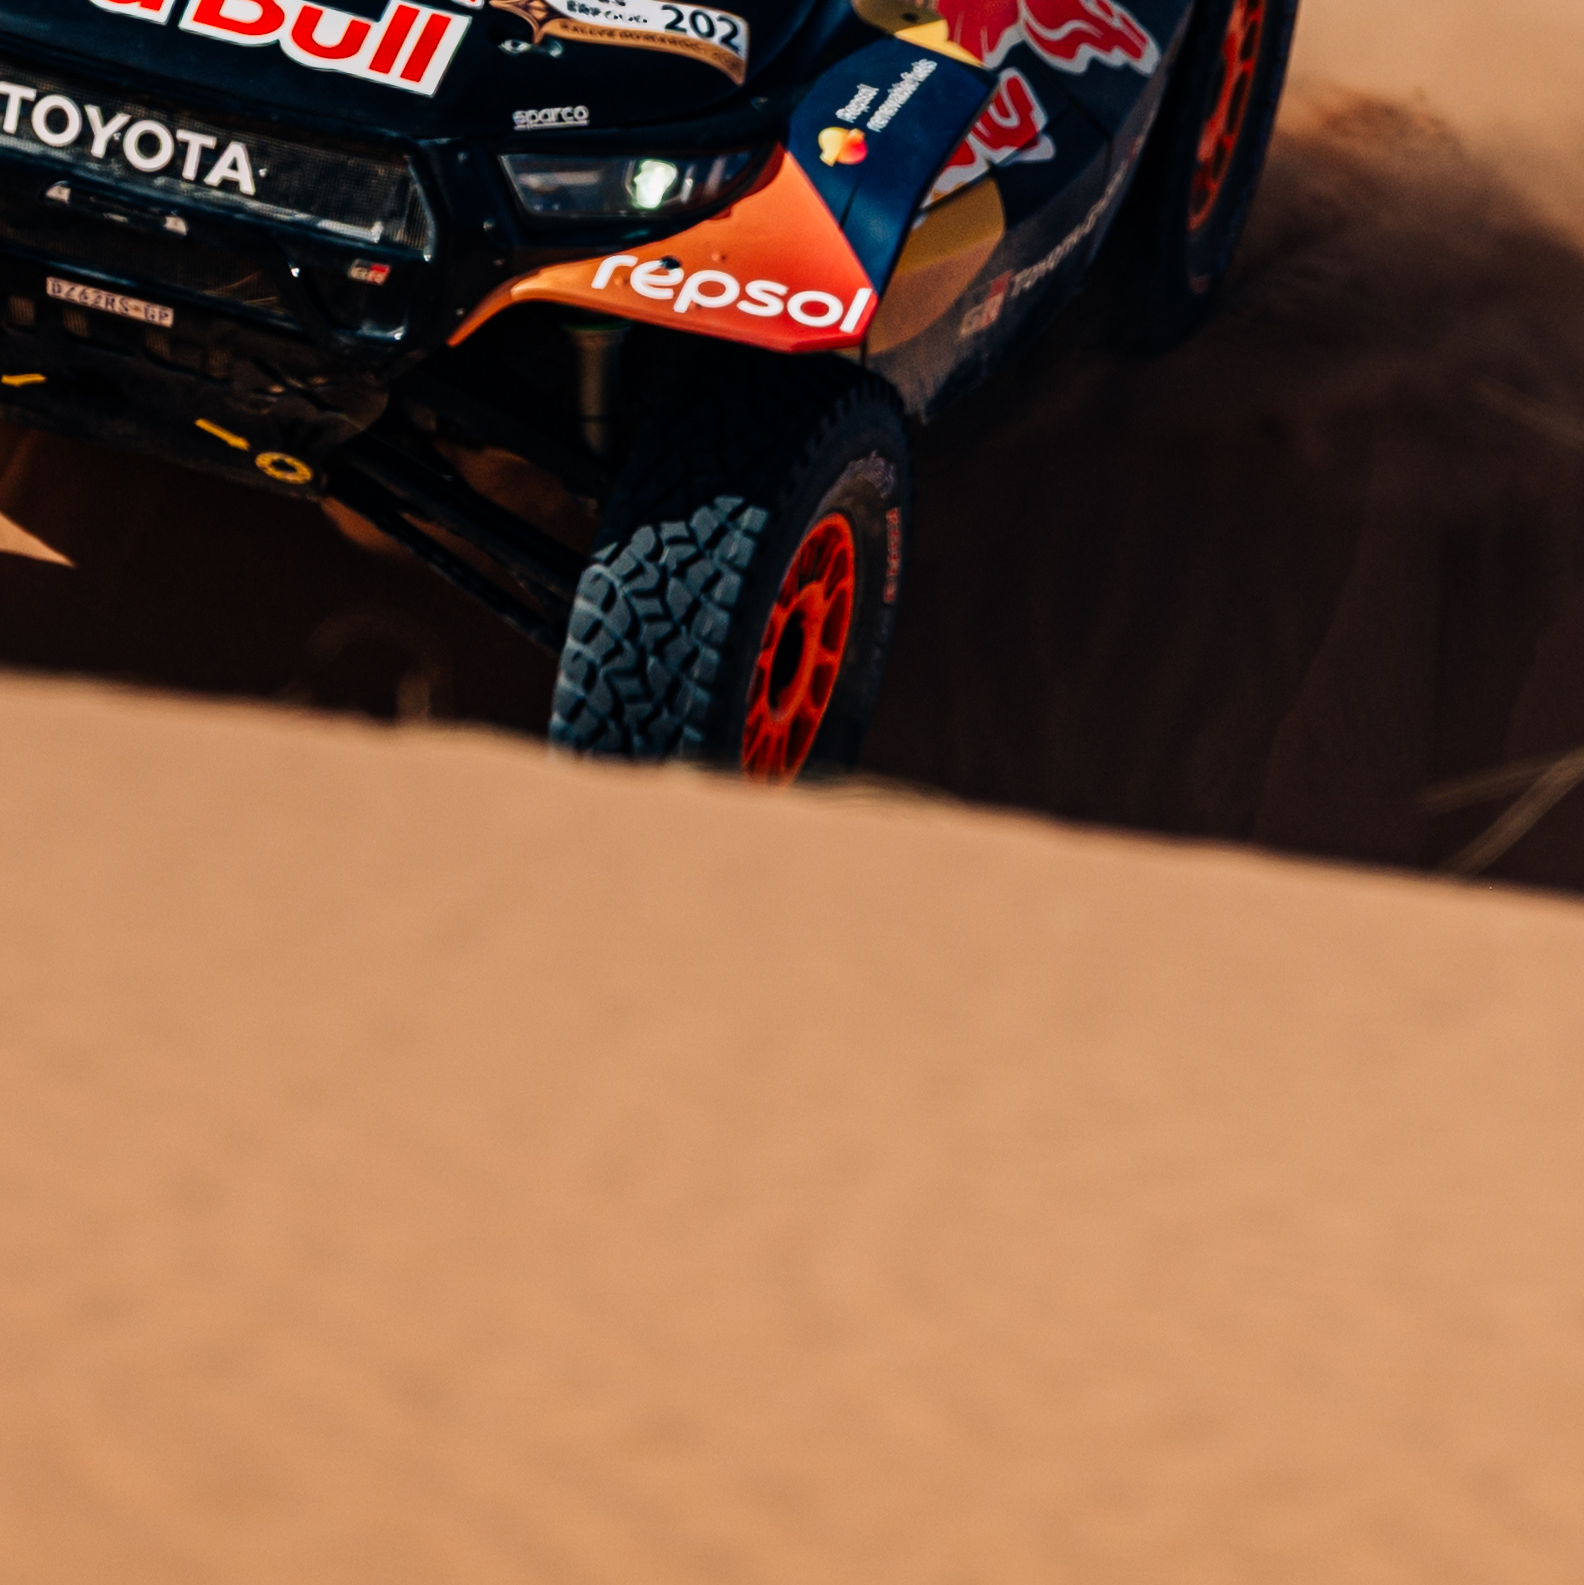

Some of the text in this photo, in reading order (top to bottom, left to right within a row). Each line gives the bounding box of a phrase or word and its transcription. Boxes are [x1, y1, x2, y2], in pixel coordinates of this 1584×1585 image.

[660, 4, 740, 56] 202
[513, 104, 590, 132] sparco
[835, 83, 880, 124] Repsol
[592, 252, 875, 335] repsol
